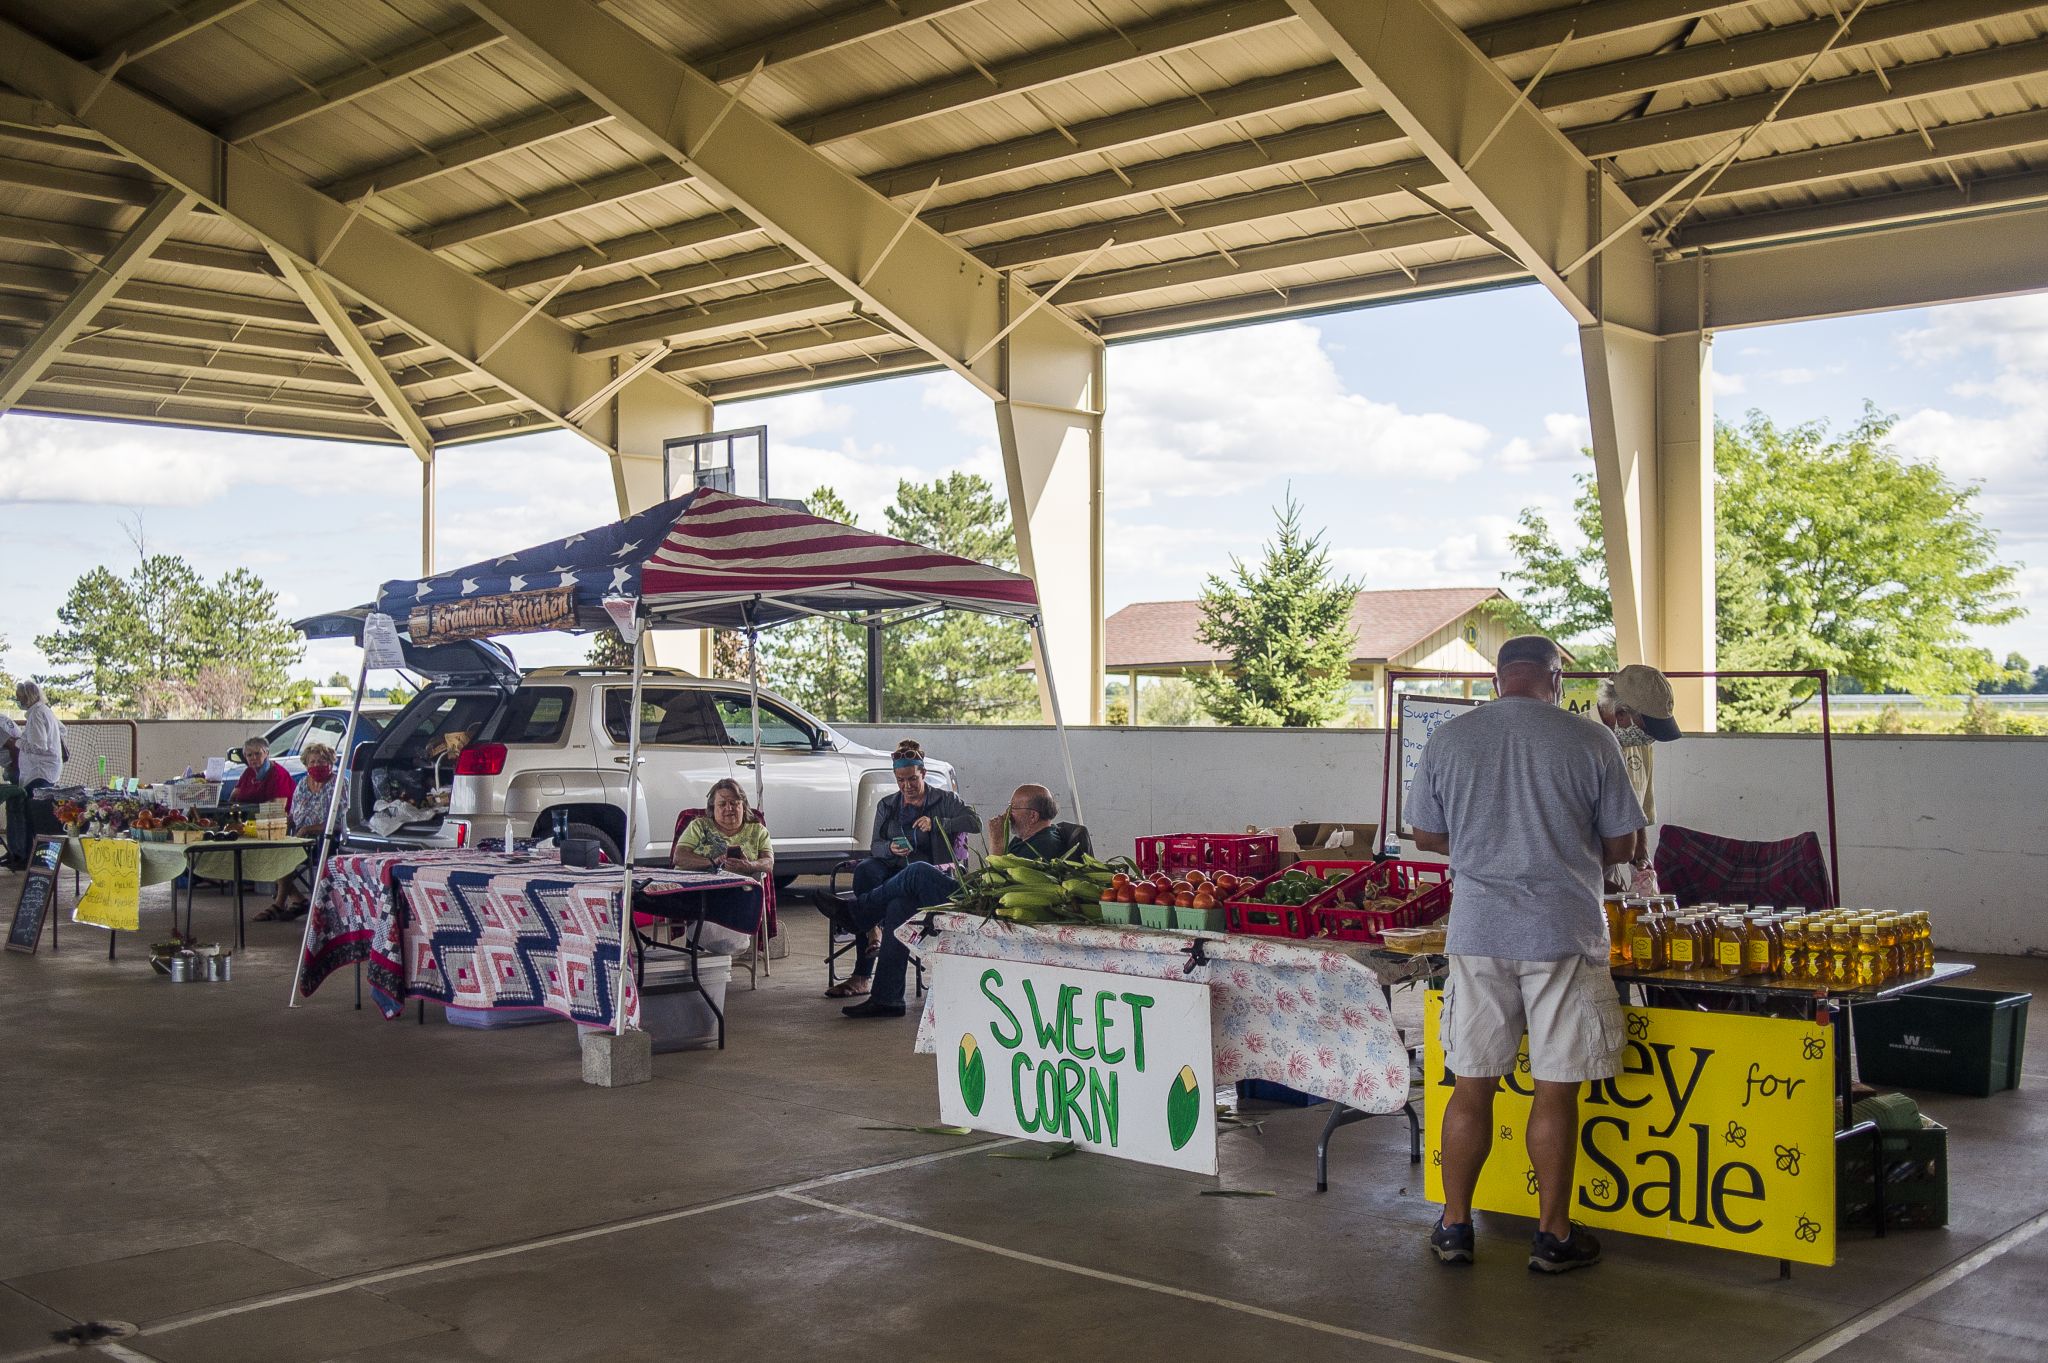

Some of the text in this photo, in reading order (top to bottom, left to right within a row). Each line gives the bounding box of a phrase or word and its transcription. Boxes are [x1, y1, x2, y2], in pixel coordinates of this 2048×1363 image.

[436, 600, 504, 634] Grandma's
[512, 593, 568, 626] Kitchen
[980, 968, 1155, 1073] SWEET
[1011, 1051, 1118, 1147] CORN
[1741, 1062, 1805, 1107] for
[1578, 1116, 1766, 1234] Sale
